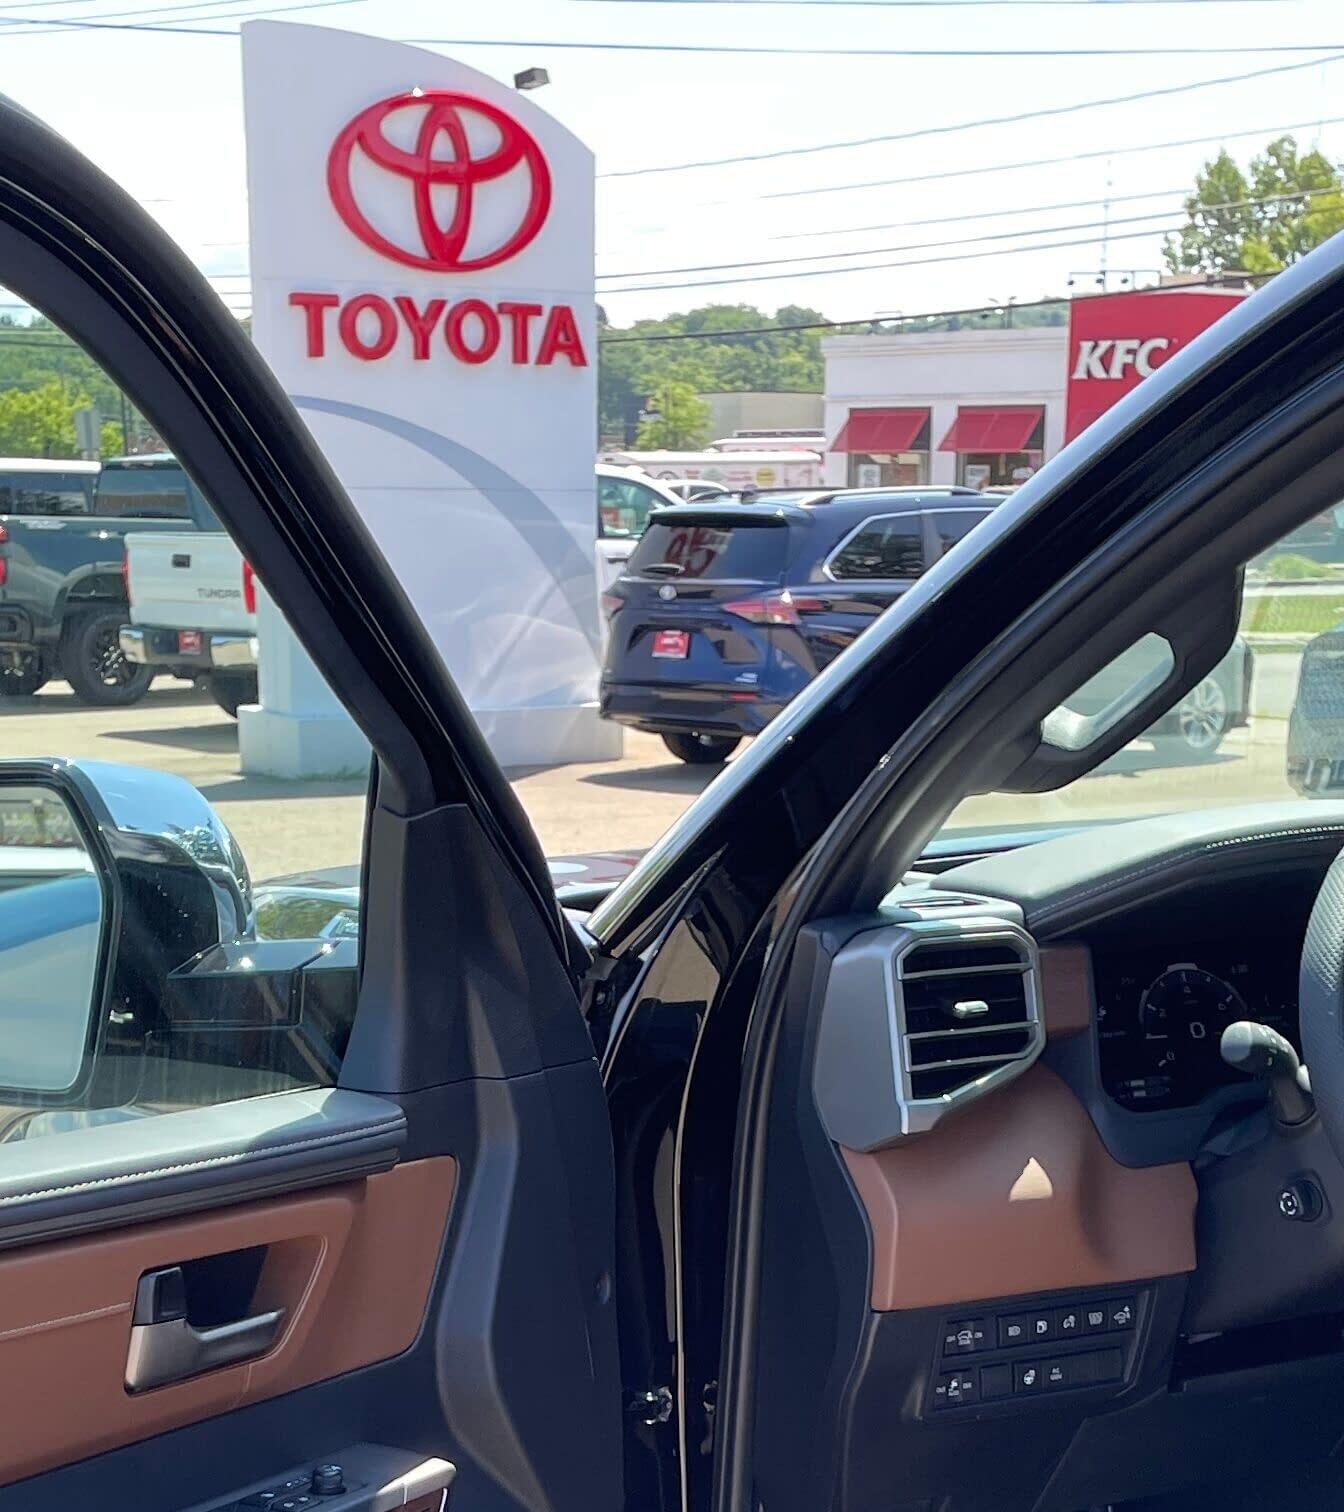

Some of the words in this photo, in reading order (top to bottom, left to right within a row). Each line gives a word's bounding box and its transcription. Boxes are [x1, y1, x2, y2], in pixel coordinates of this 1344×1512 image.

[289, 292, 587, 366] TOYOTA
[1071, 338, 1168, 380] KFC
[197, 587, 241, 598] TUNDRA
